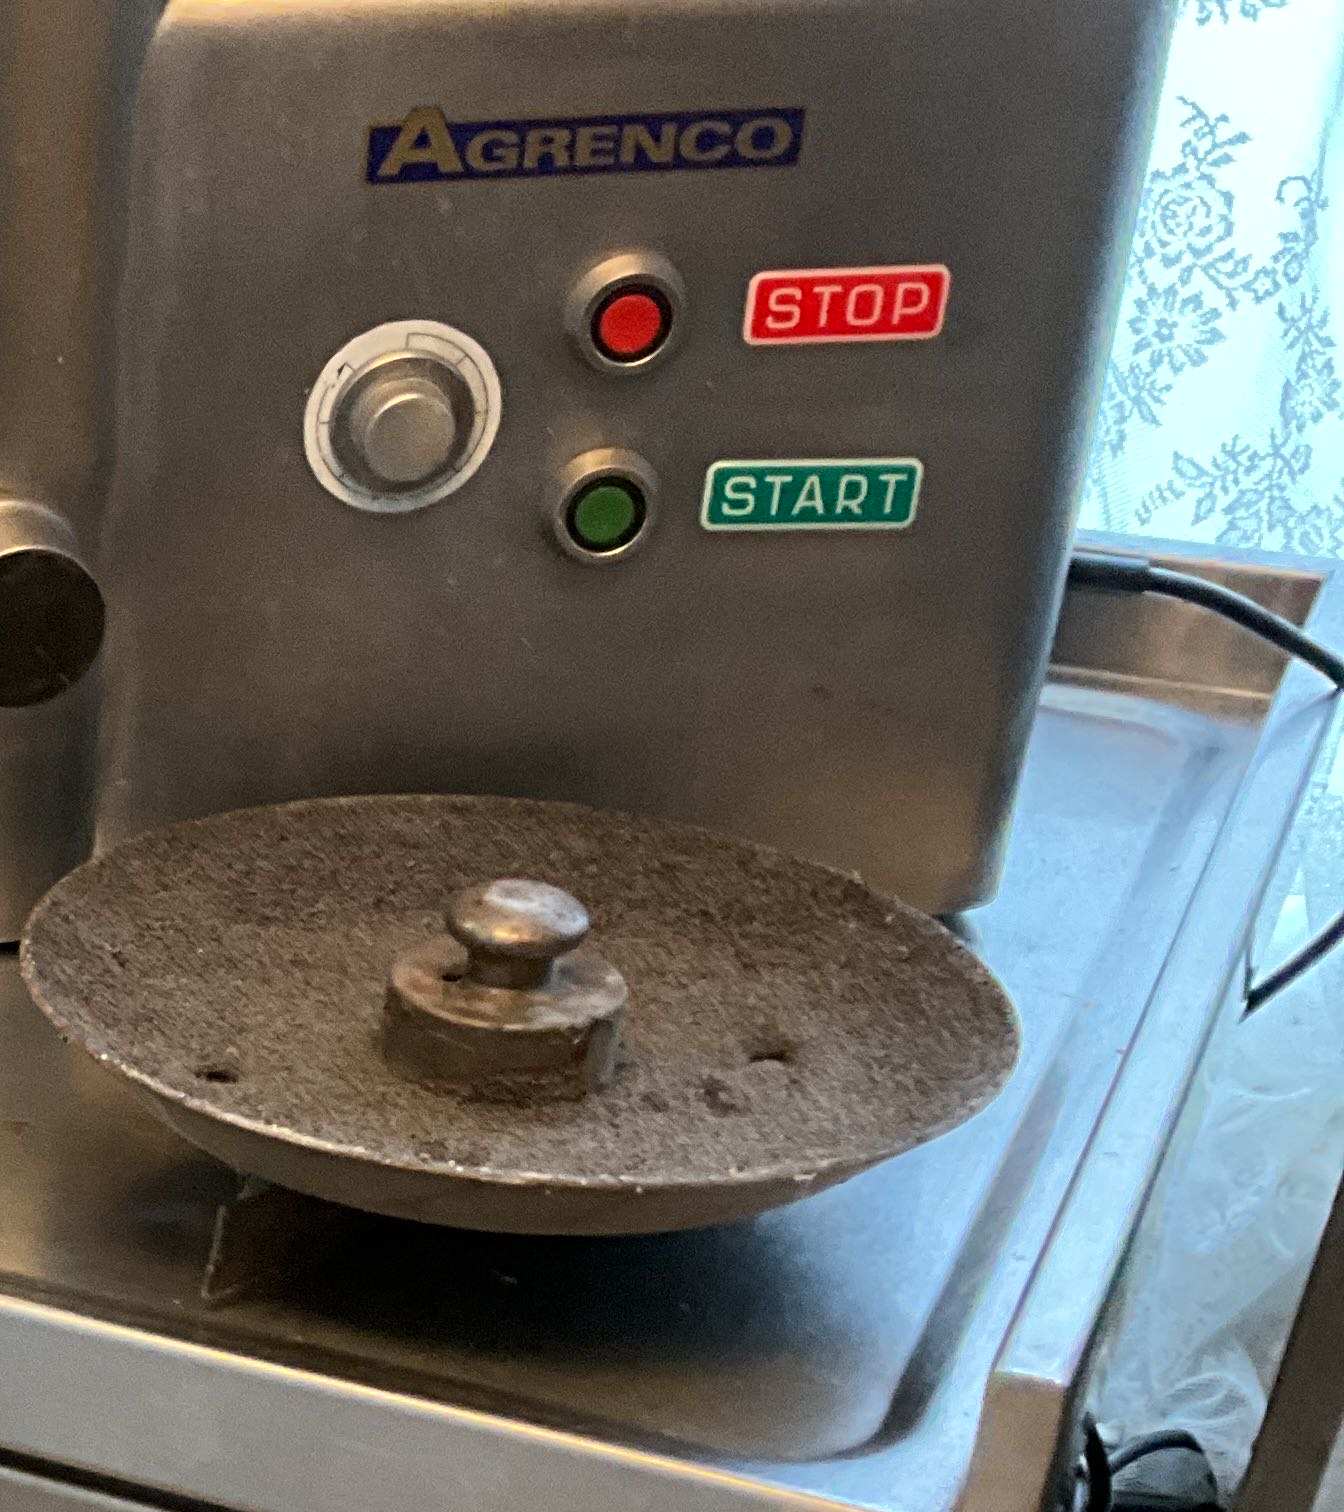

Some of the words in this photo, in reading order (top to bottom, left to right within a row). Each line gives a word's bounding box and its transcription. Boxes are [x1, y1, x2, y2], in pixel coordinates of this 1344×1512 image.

[377, 106, 793, 177] AGRENCO
[765, 283, 931, 331] STOP
[720, 473, 909, 518] START
